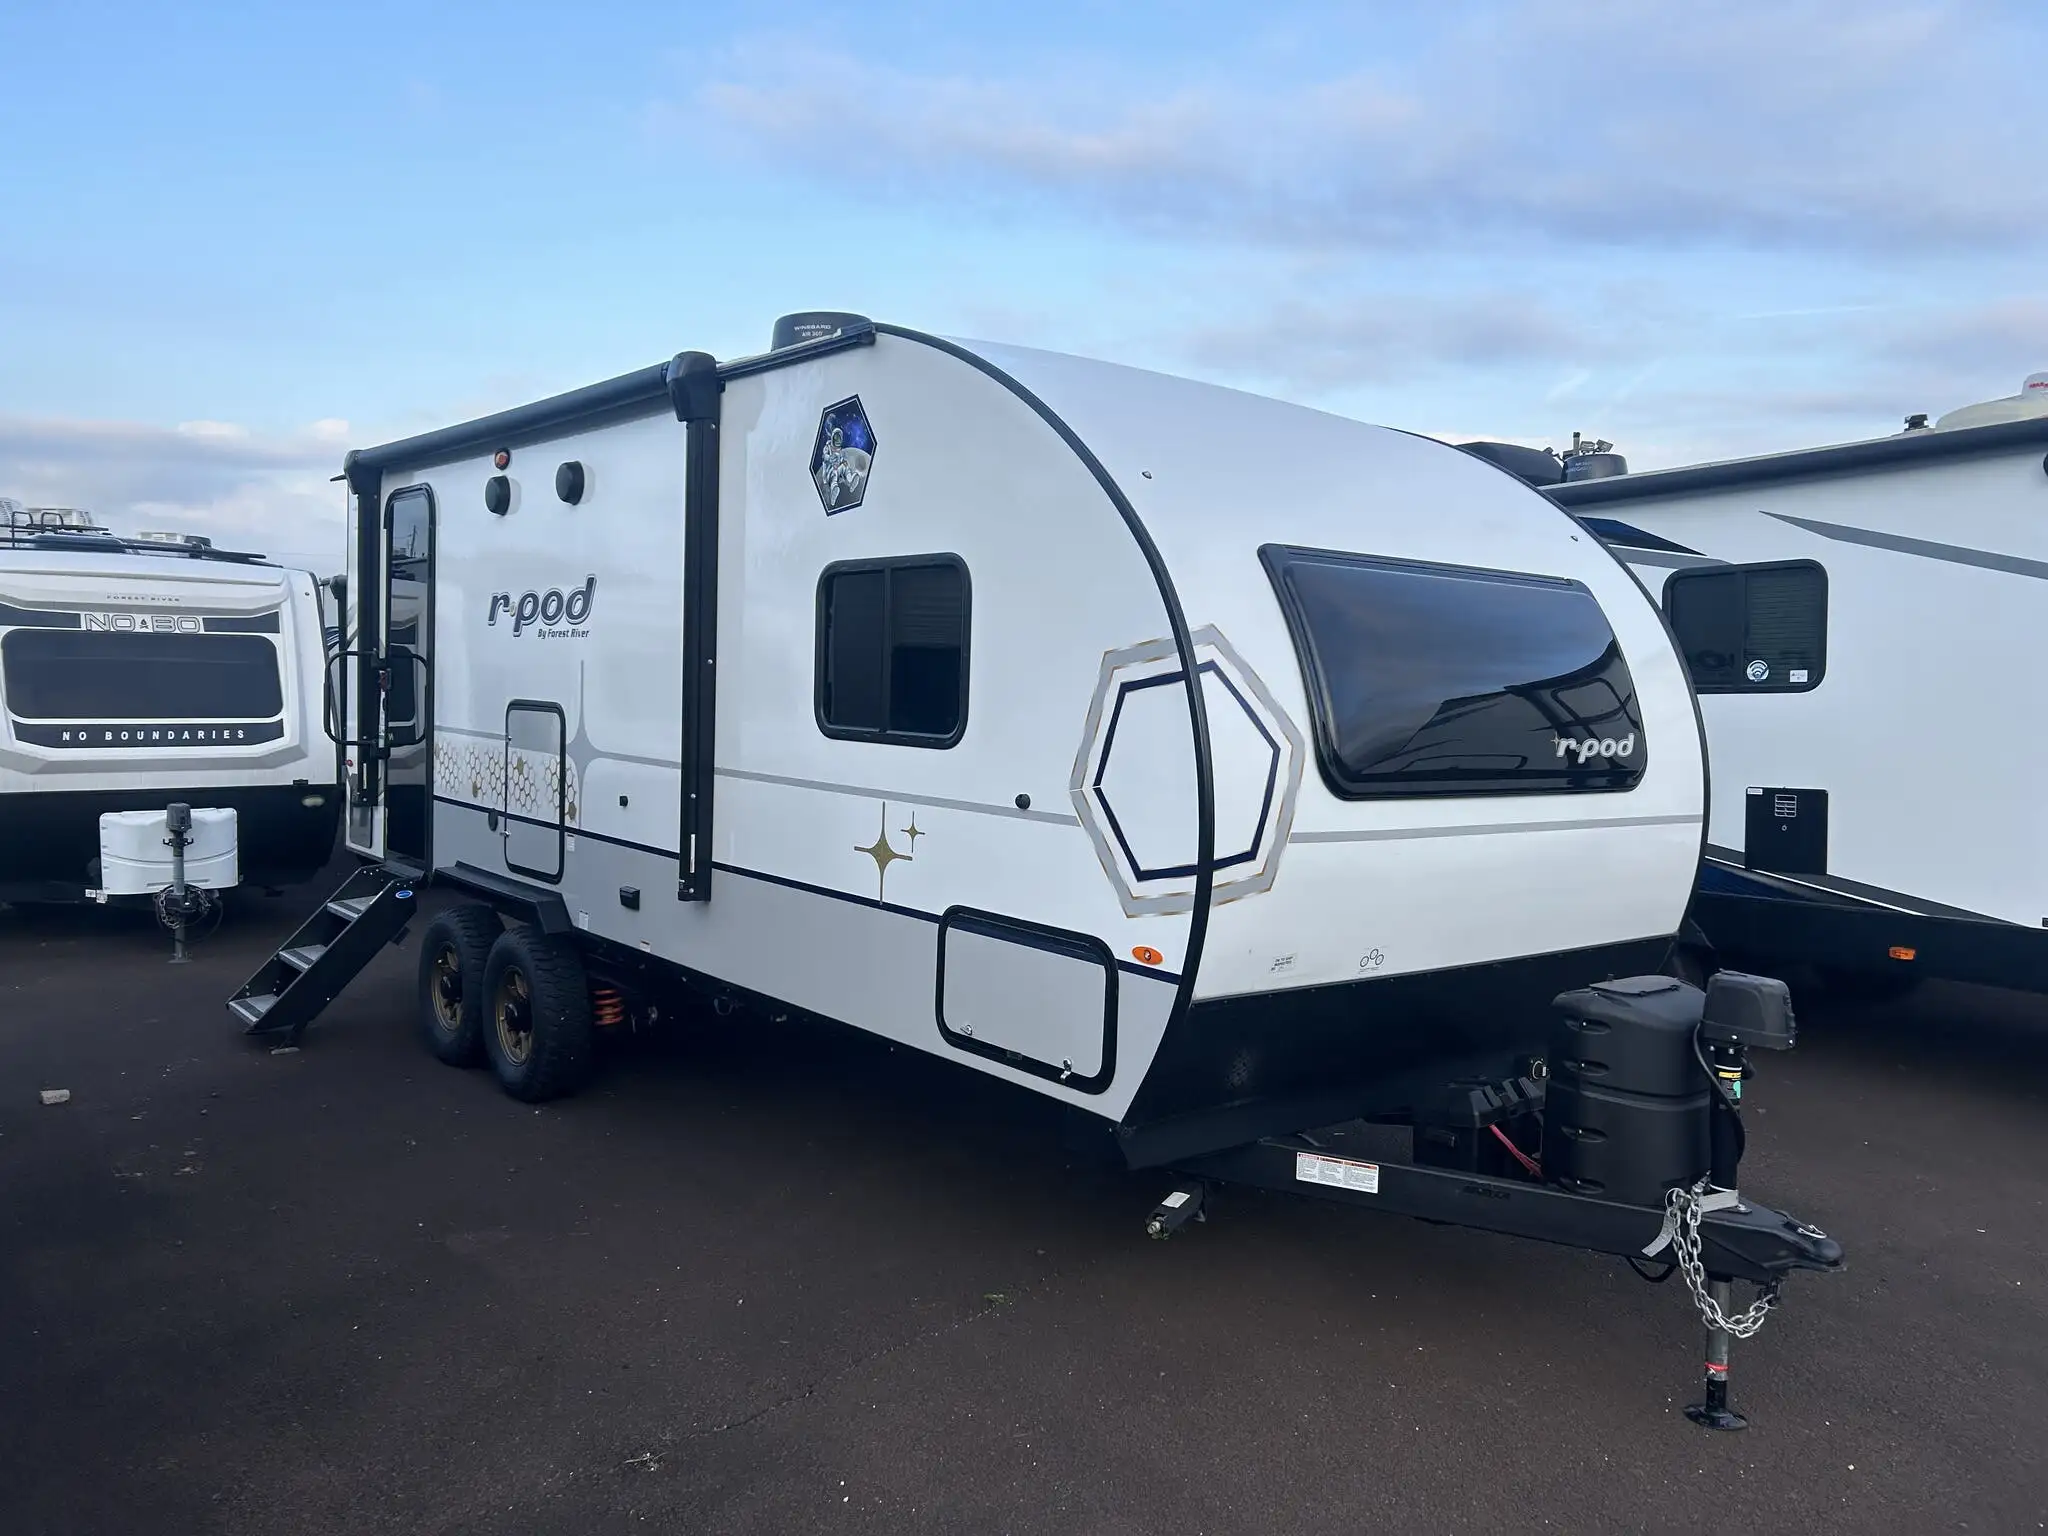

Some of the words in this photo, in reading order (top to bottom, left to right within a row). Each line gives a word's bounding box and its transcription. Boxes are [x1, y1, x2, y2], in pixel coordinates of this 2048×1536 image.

[537, 628, 547, 640] By
[547, 628, 570, 638] Forest
[570, 628, 590, 638] River
[62, 731, 87, 741] NO
[105, 730, 245, 741] BOUNDARIES
